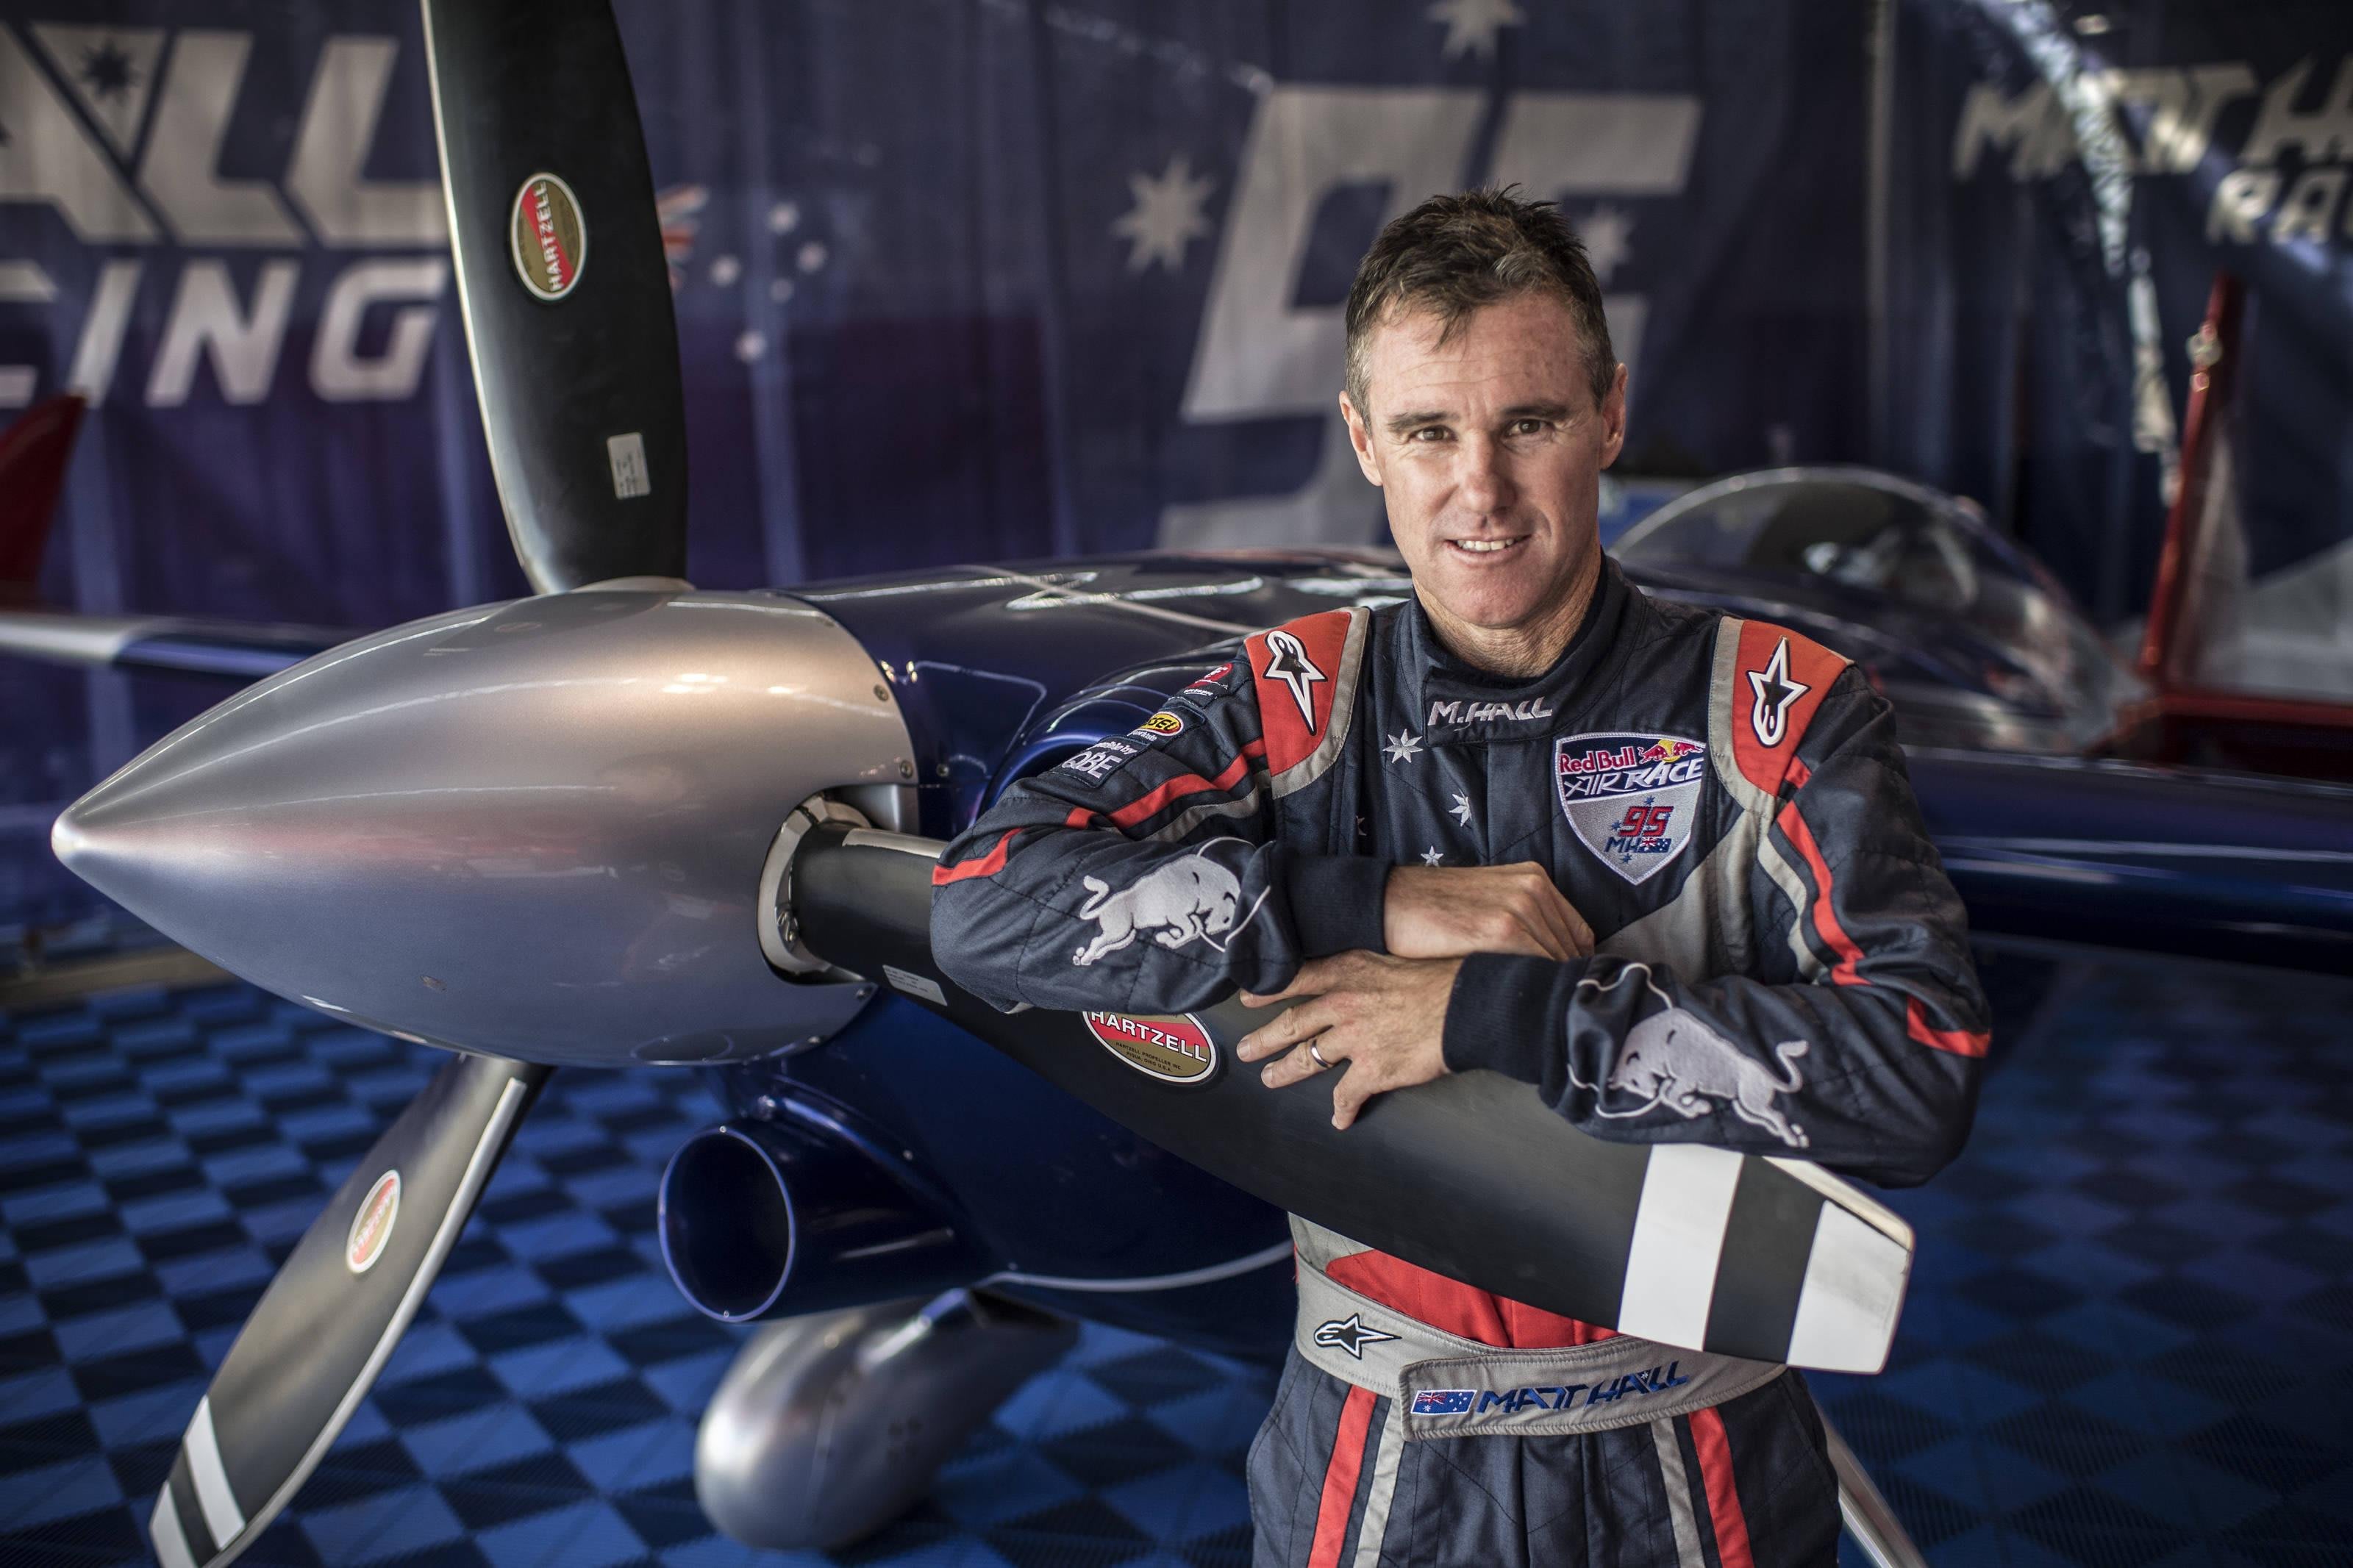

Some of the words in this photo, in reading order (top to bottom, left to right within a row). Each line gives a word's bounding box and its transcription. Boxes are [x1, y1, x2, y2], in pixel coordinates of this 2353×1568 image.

[533, 182, 565, 291] HARTZELL
[1061, 751, 1123, 778] QBE
[1560, 751, 1595, 773] Red
[1596, 746, 1637, 770] Bull
[1623, 757, 1704, 789] RACE
[1618, 806, 1674, 837] 95
[1091, 1012, 1207, 1063] HARTZELL
[1115, 1042, 1140, 1054] HARTZELL
[1141, 1052, 1171, 1066] PROPELLER
[1143, 1058, 1157, 1066] OHIO
[1476, 1384, 1588, 1414] MATT
[1584, 1361, 1690, 1406] HALL
